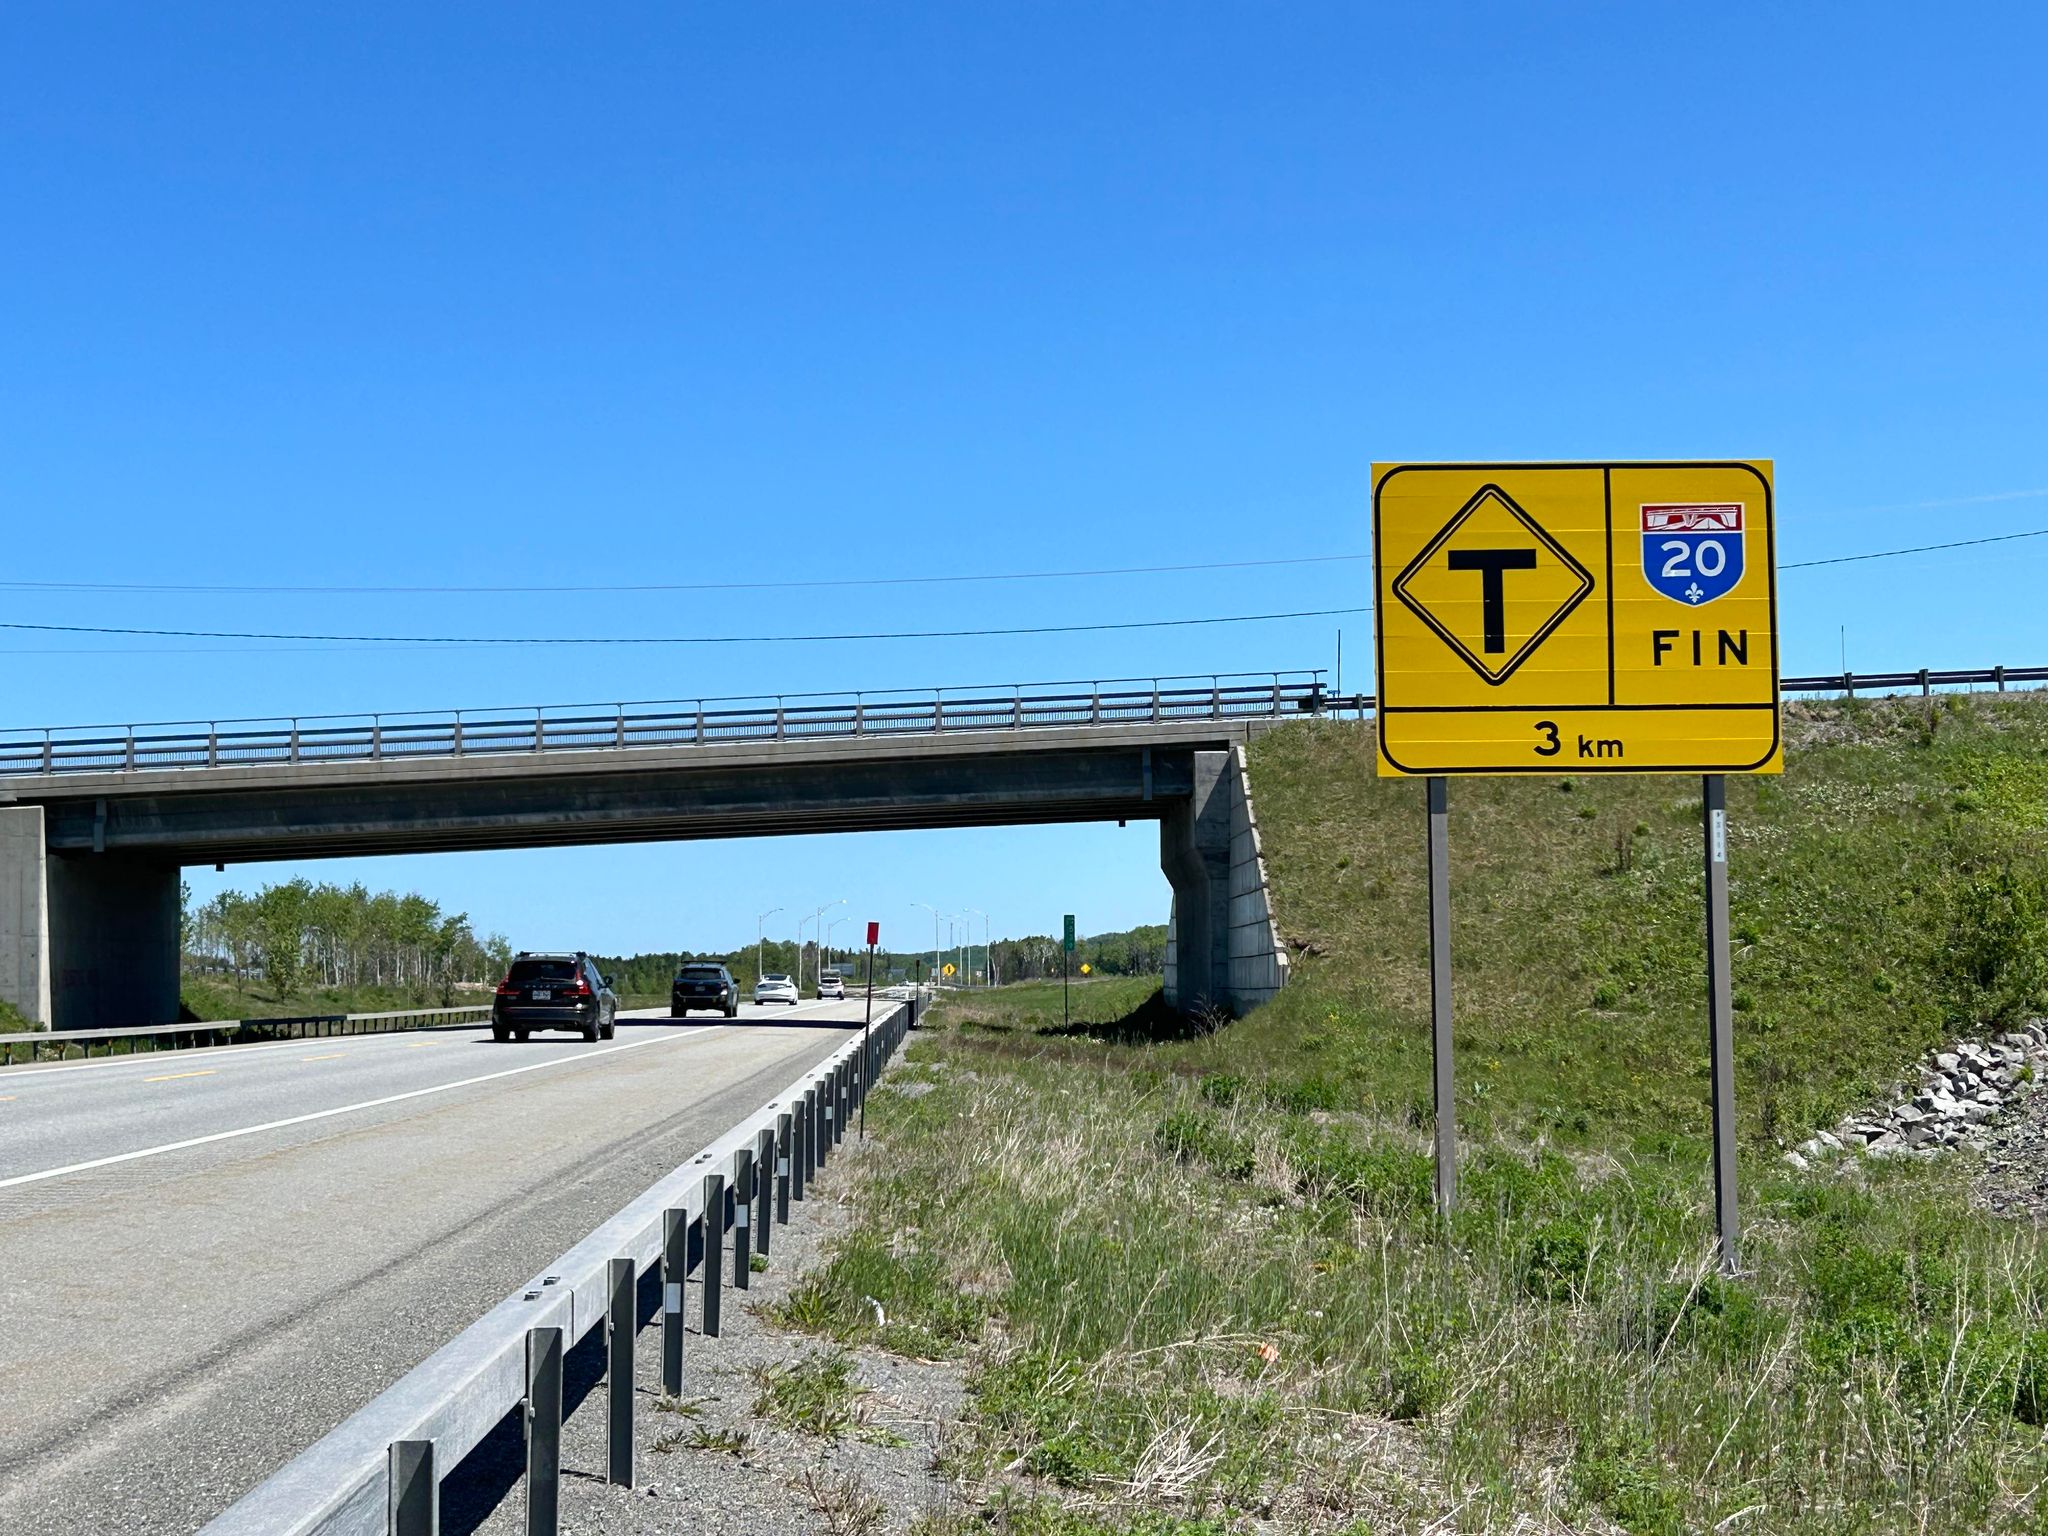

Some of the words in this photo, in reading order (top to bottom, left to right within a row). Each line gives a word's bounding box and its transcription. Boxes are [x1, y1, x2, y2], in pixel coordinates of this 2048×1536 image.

[1661, 540, 1726, 577] 20
[1652, 629, 1748, 666] FIN
[1533, 720, 1562, 757] 3
[1578, 734, 1624, 758] km
